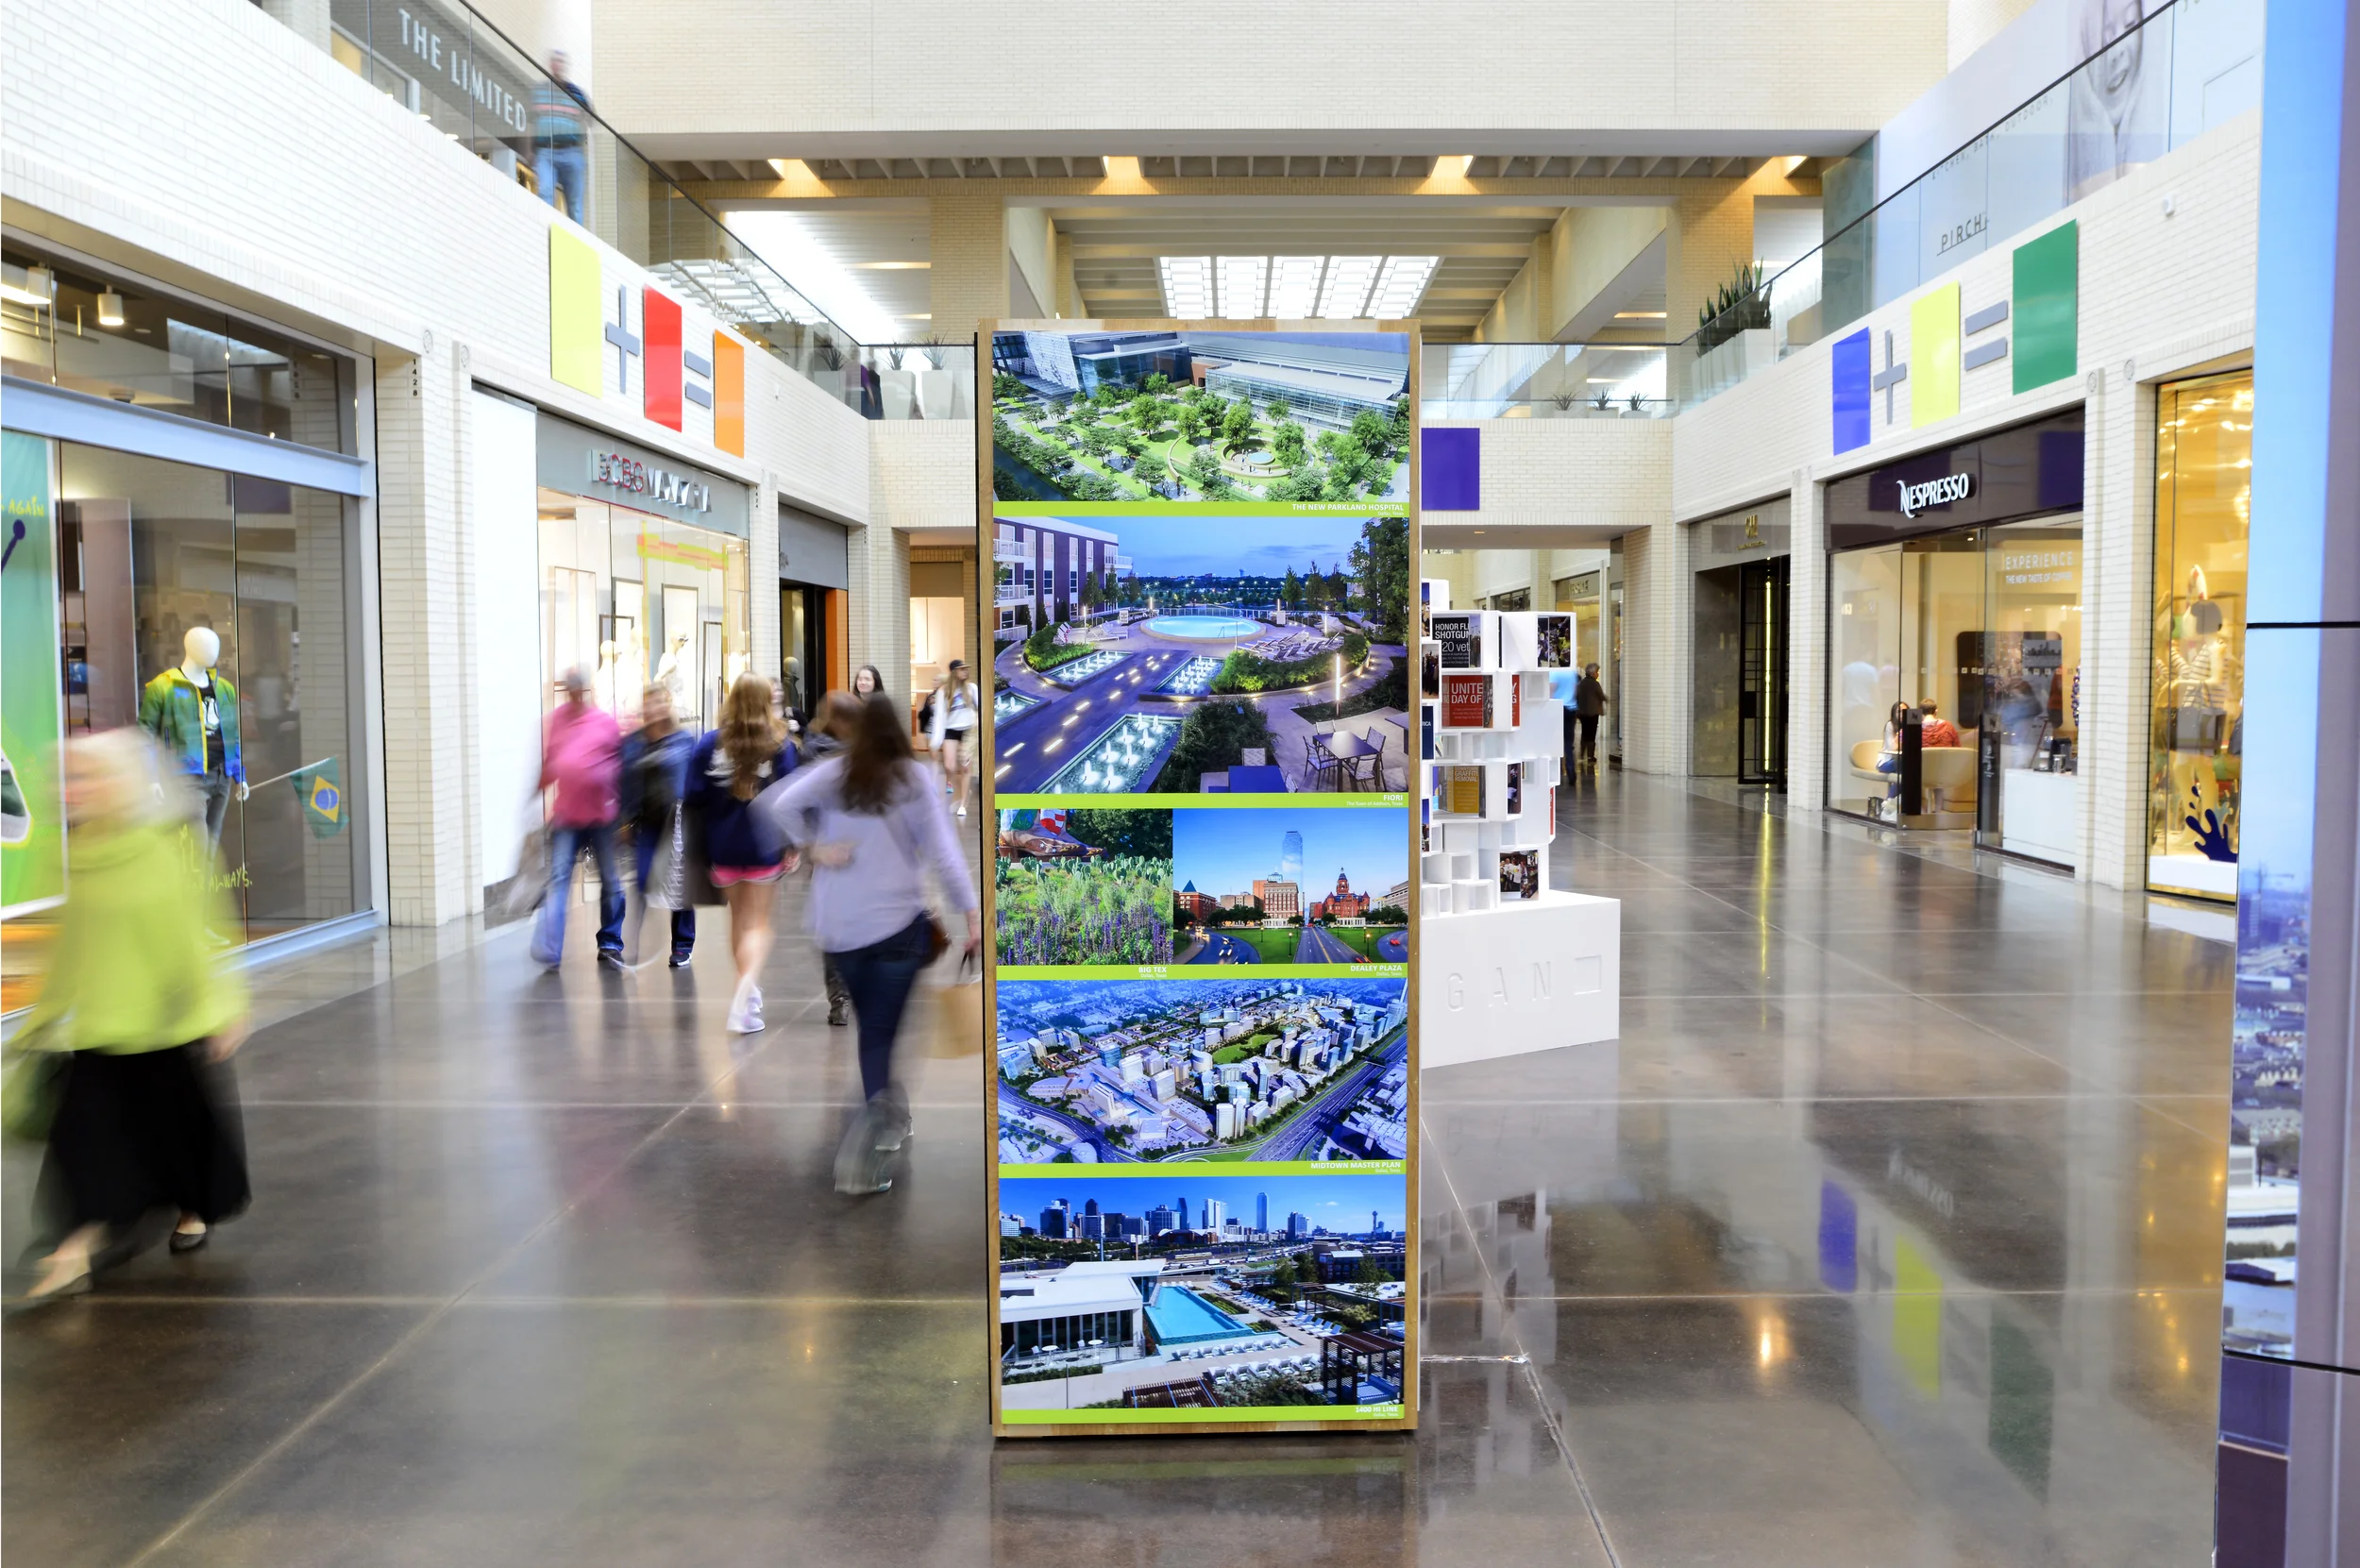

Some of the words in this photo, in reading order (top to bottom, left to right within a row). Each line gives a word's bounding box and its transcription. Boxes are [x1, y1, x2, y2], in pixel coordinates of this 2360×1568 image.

[398, 8, 442, 71] THE
[450, 50, 527, 132] LIMITED
[1896, 472, 1969, 518] NESPRESSO
[2005, 550, 2073, 570] EXPERIENCE
[1451, 695, 1469, 704] DAY
[1470, 695, 1482, 704] OF
